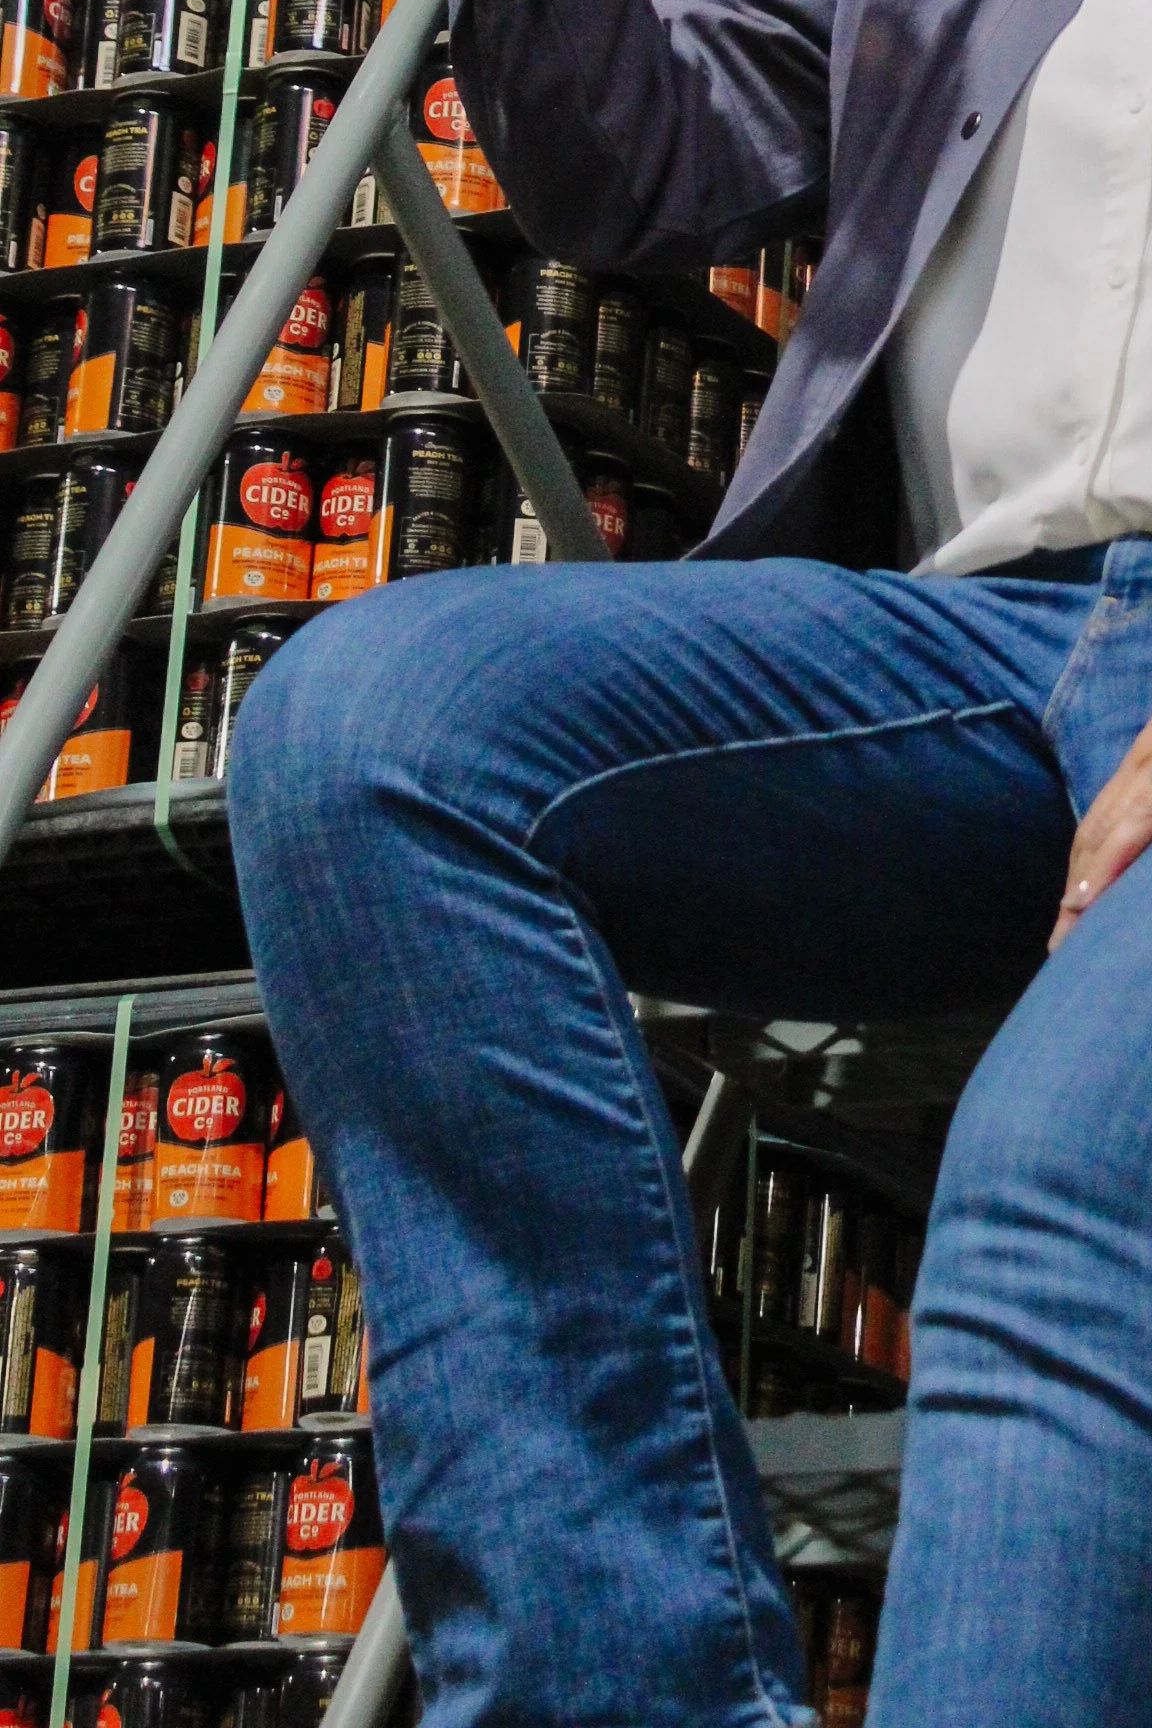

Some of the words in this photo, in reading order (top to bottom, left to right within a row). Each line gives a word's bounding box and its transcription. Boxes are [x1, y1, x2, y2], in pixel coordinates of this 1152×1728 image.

[245, 484, 311, 514] CIDER
[232, 547, 284, 563] PEACH
[172, 1095, 241, 1118] CIDER
[0, 1108, 47, 1131] IDER
[160, 1163, 208, 1178] PEACH
[211, 1162, 242, 1178] TEA
